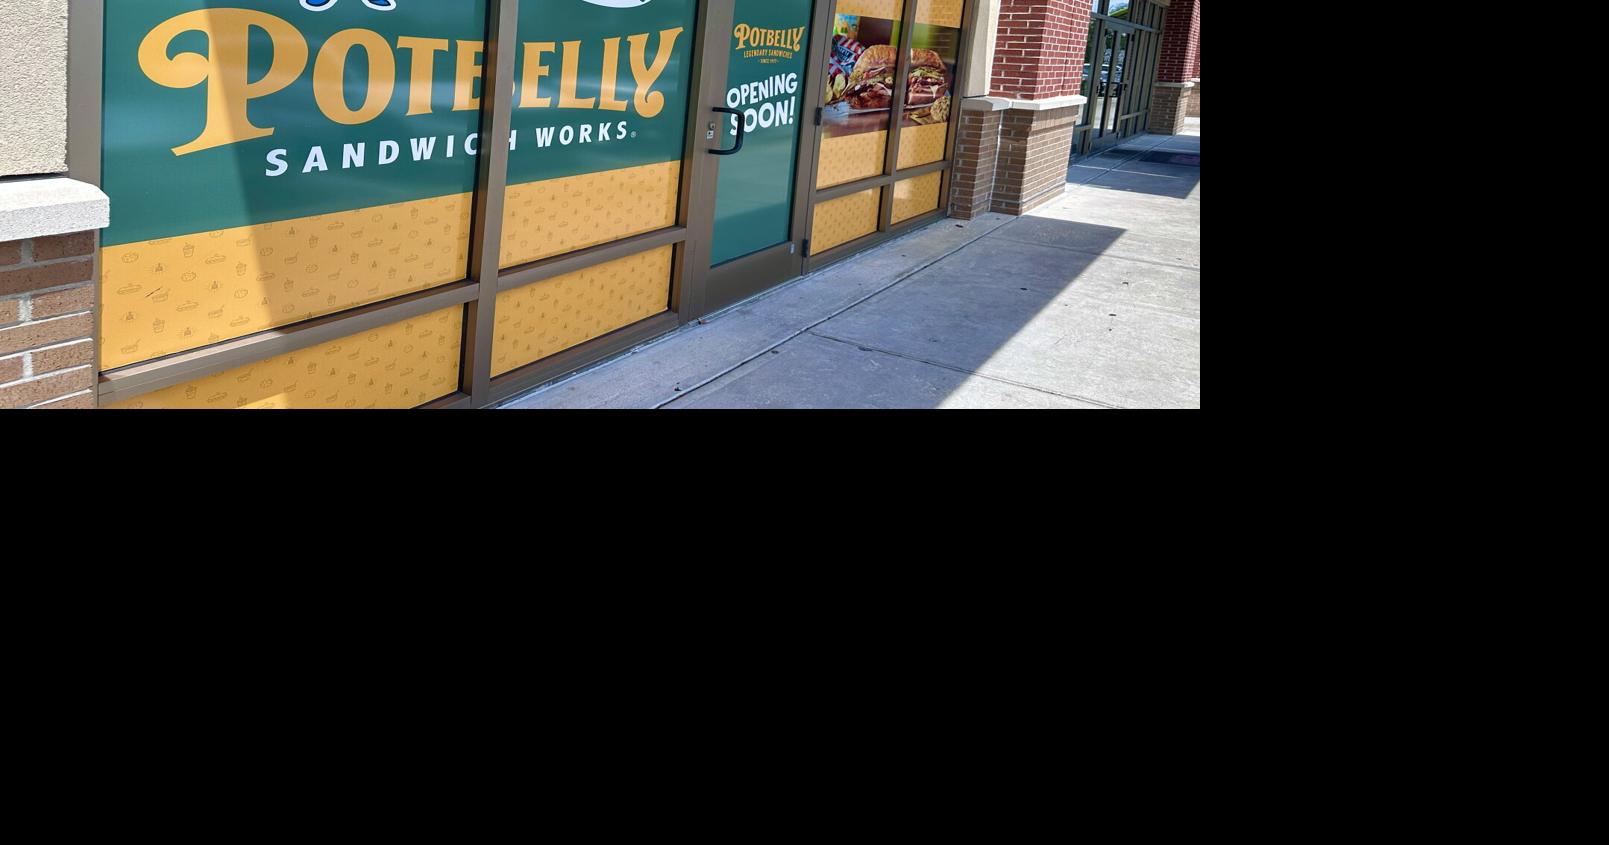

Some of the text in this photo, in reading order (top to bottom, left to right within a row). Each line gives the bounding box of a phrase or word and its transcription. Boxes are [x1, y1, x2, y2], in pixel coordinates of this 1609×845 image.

[734, 23, 805, 52] POTBELLY
[726, 72, 798, 108] OPENING
[729, 96, 796, 136] SOON!
[265, 129, 517, 177] SANDWICH
